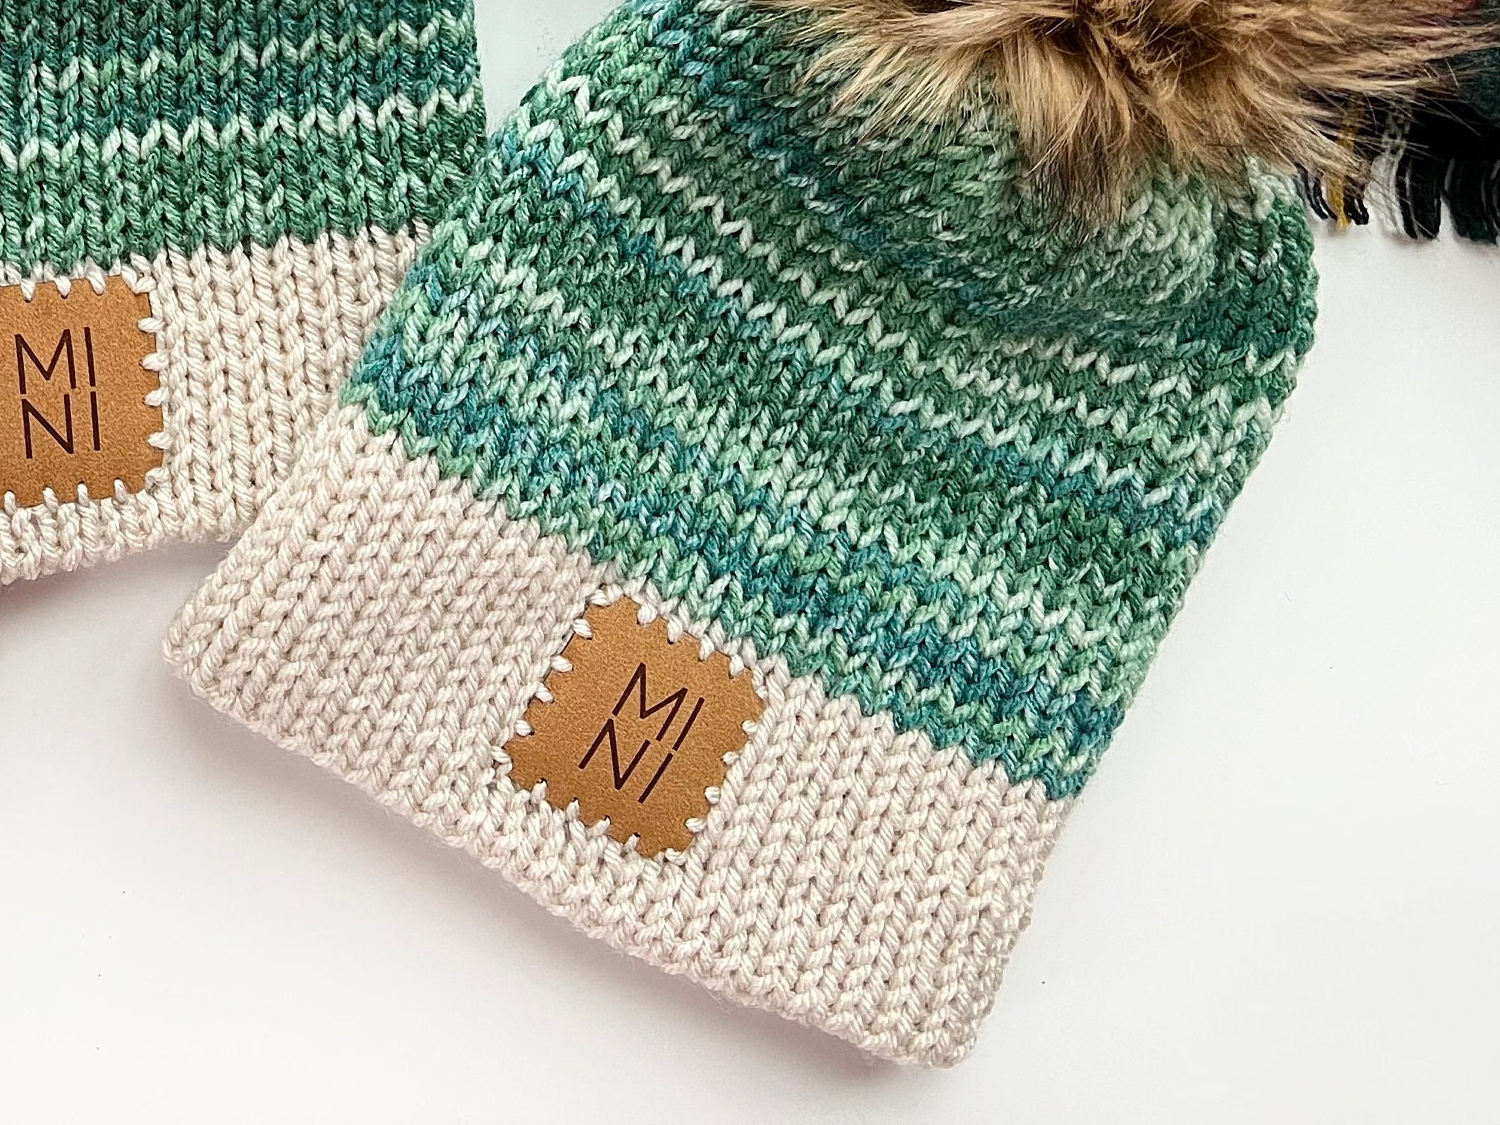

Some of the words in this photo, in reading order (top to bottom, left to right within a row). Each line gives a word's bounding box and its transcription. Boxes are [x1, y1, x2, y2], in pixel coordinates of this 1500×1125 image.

[14, 327, 96, 395] MI
[21, 391, 101, 459] NI
[612, 662, 705, 751] MI
[578, 718, 674, 804] NI
